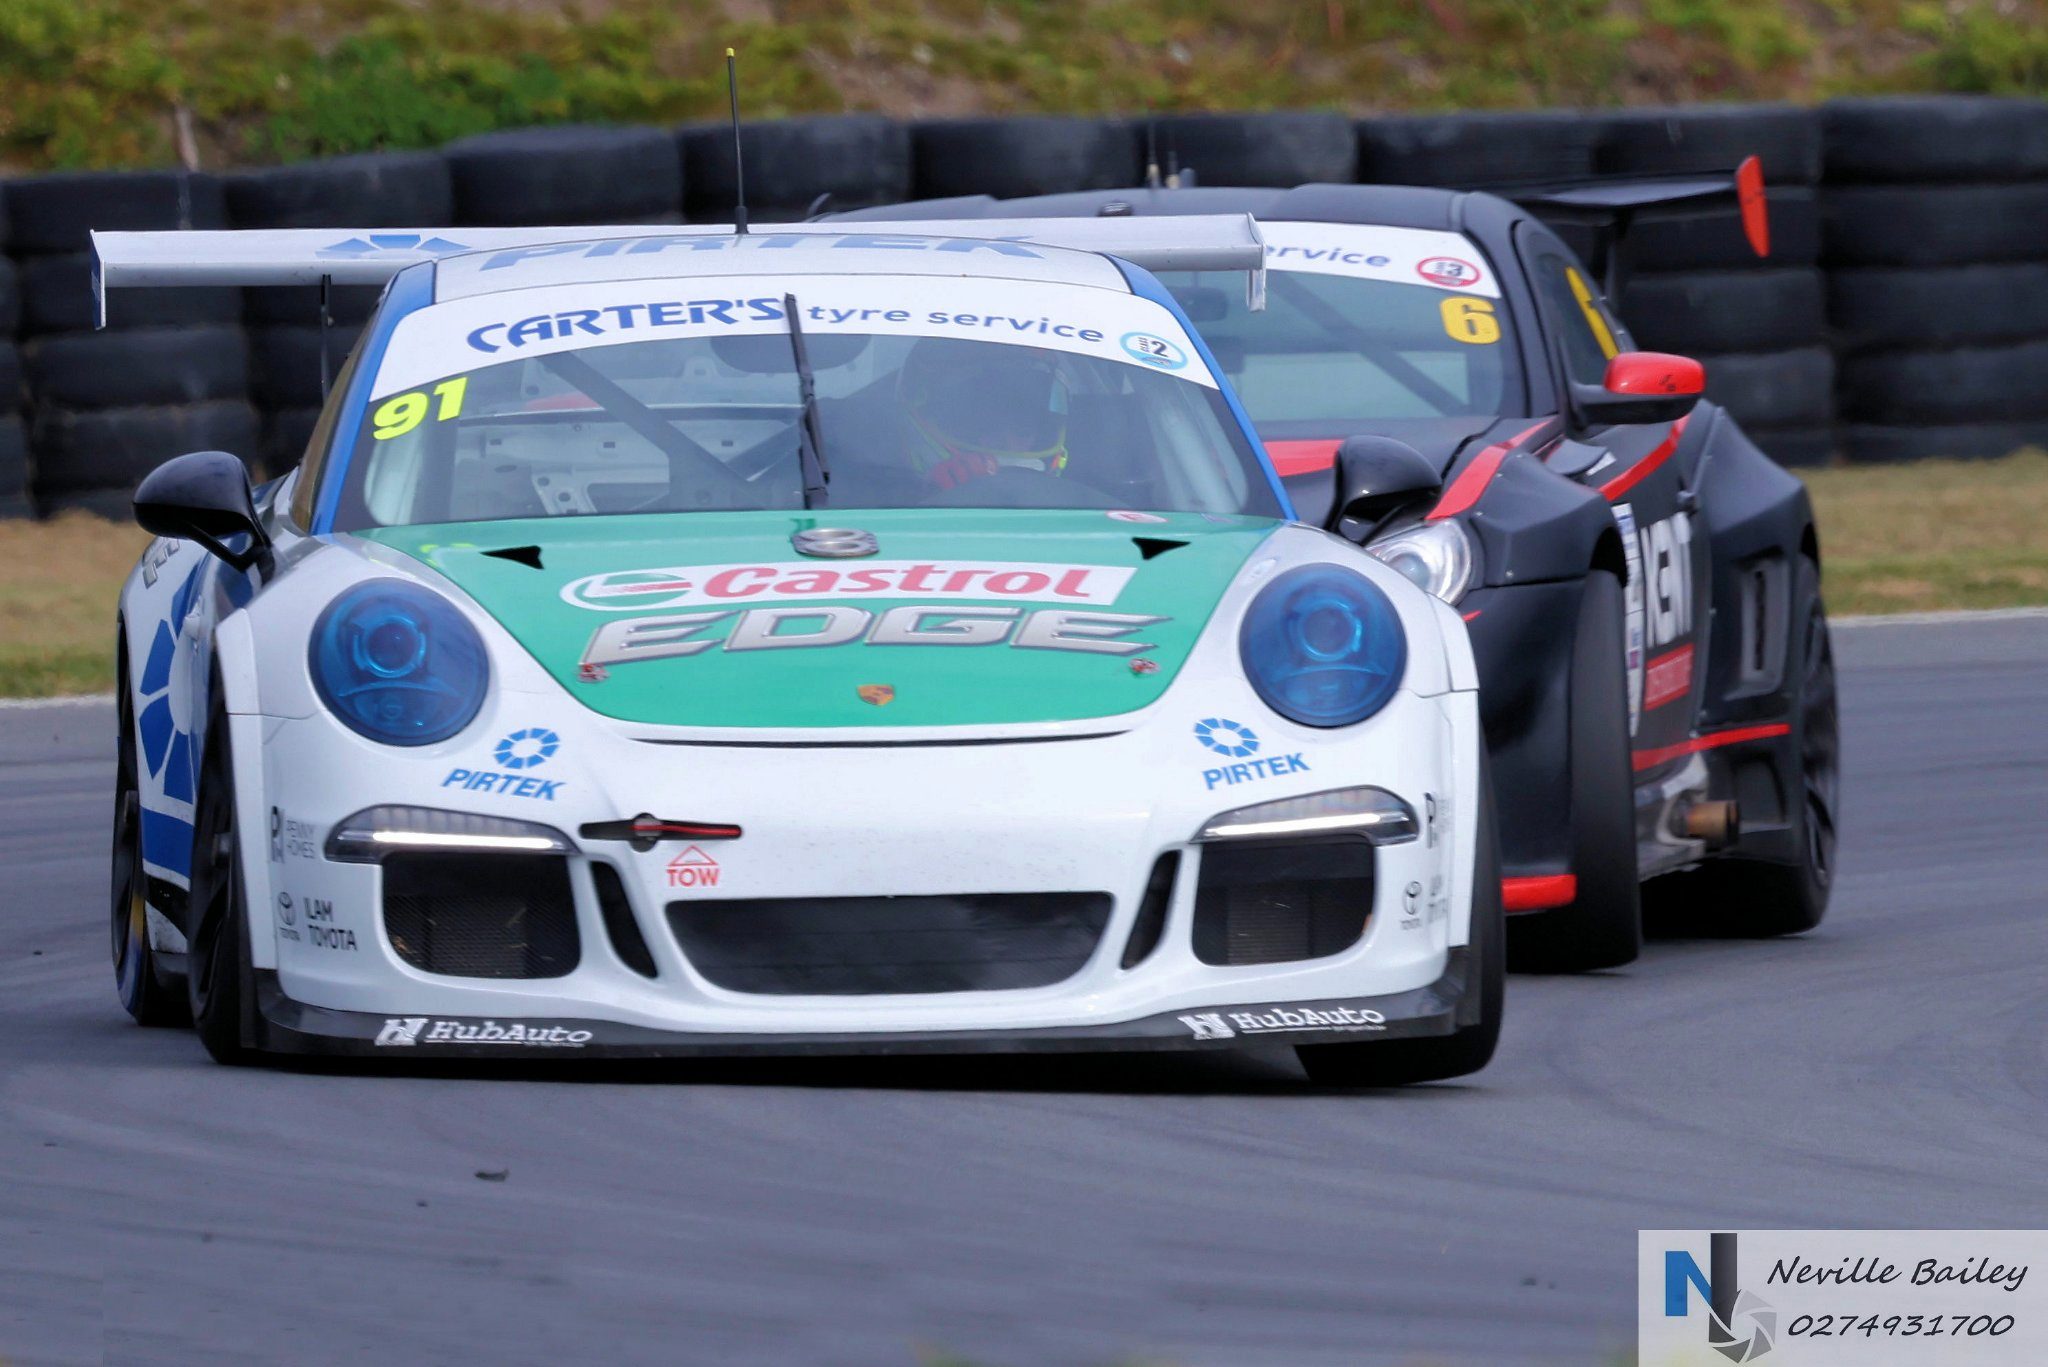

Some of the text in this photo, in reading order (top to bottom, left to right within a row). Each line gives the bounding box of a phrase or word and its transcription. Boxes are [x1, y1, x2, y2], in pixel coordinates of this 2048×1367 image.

[1265, 245, 1392, 267] rvice
[467, 298, 1104, 353] CARTER'S tyre service
[1440, 296, 1500, 344] 6
[1151, 340, 1169, 357] 2
[373, 377, 468, 441] 91
[704, 565, 1091, 599] Castrol
[579, 606, 1174, 666] EDGE
[441, 767, 565, 801] PIRTEK
[1201, 752, 1311, 791] PIRTEK
[666, 867, 721, 888] TOW
[308, 923, 358, 951] TOYOTA
[425, 1019, 594, 1043] HubAuto
[1228, 1006, 1386, 1031] HubAuto
